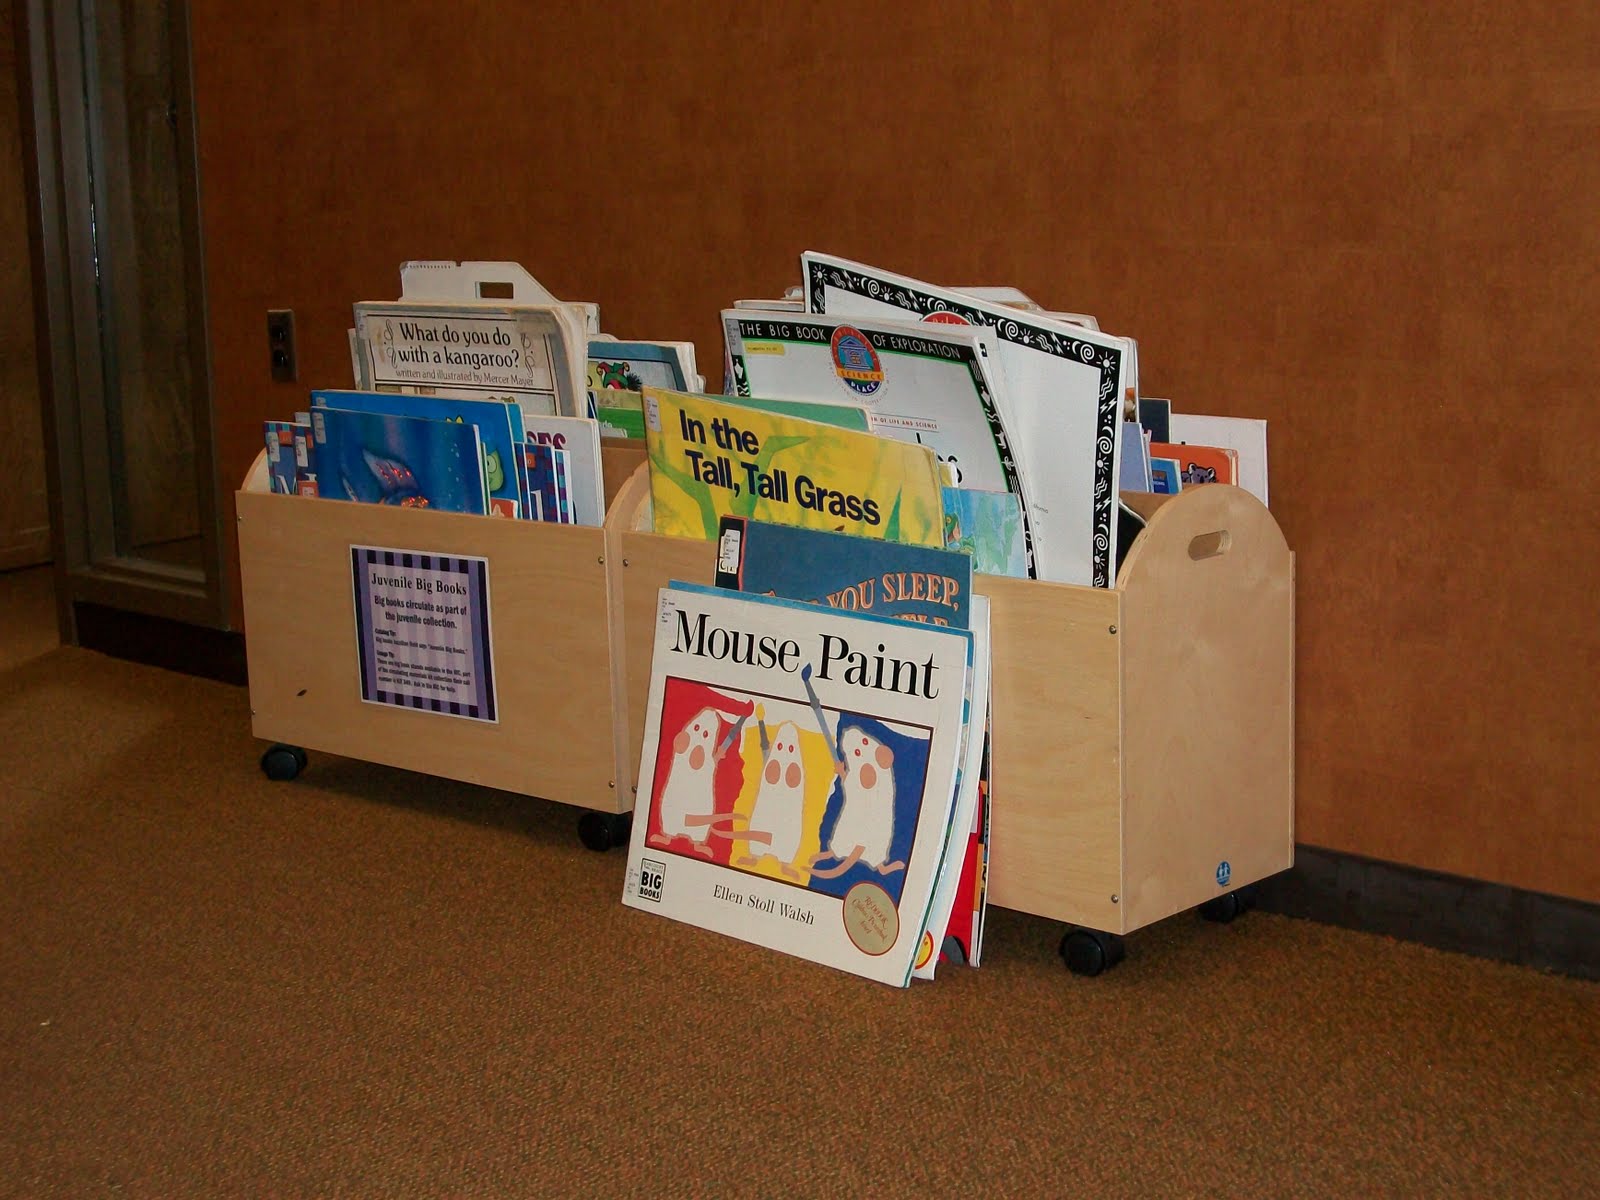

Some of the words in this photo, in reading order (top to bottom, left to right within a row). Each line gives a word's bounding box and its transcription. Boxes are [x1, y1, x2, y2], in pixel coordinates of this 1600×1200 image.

[399, 322, 439, 342] What
[442, 324, 460, 343] do
[463, 332, 490, 347] you
[493, 327, 511, 346] do
[740, 323, 762, 336] THE
[769, 324, 790, 338] BIG
[796, 326, 827, 341] BOOK
[873, 334, 888, 348] OF
[890, 336, 961, 359] EXPLORATION
[398, 345, 430, 363] with
[432, 350, 442, 363] a
[444, 346, 520, 370] kangaroo?
[395, 369, 421, 378] written
[422, 370, 436, 379] and
[437, 371, 473, 381] illustrated
[473, 372, 483, 384] by
[484, 373, 510, 385] Mercer
[510, 375, 534, 388] Mayer
[841, 370, 881, 380] SCIENCE
[851, 381, 876, 394] PLACE
[679, 409, 707, 445] In
[711, 417, 760, 456] the
[915, 421, 938, 430] SCIENCE
[684, 449, 741, 498] Tall,
[741, 461, 789, 504] Tall
[794, 475, 881, 526] Grass
[371, 572, 413, 590] Juvenile
[416, 577, 433, 595] Big
[436, 580, 467, 596] Books
[826, 578, 876, 611] YOU
[882, 572, 960, 612] SLEEP,
[374, 595, 386, 607] Big
[386, 596, 405, 608] books
[406, 599, 435, 612] circulate
[436, 604, 444, 613] as
[445, 605, 460, 616] part
[460, 606, 468, 616] of
[385, 611, 396, 620] the
[396, 612, 422, 624] juvenile
[422, 616, 458, 630] collection.
[670, 609, 801, 675] Mouse
[815, 633, 941, 700] Paint
[641, 870, 662, 890] BIG
[640, 886, 660, 900] BOOKS
[713, 883, 743, 905] Ellen
[747, 894, 775, 914] Stoll
[779, 902, 815, 926] Walsh
